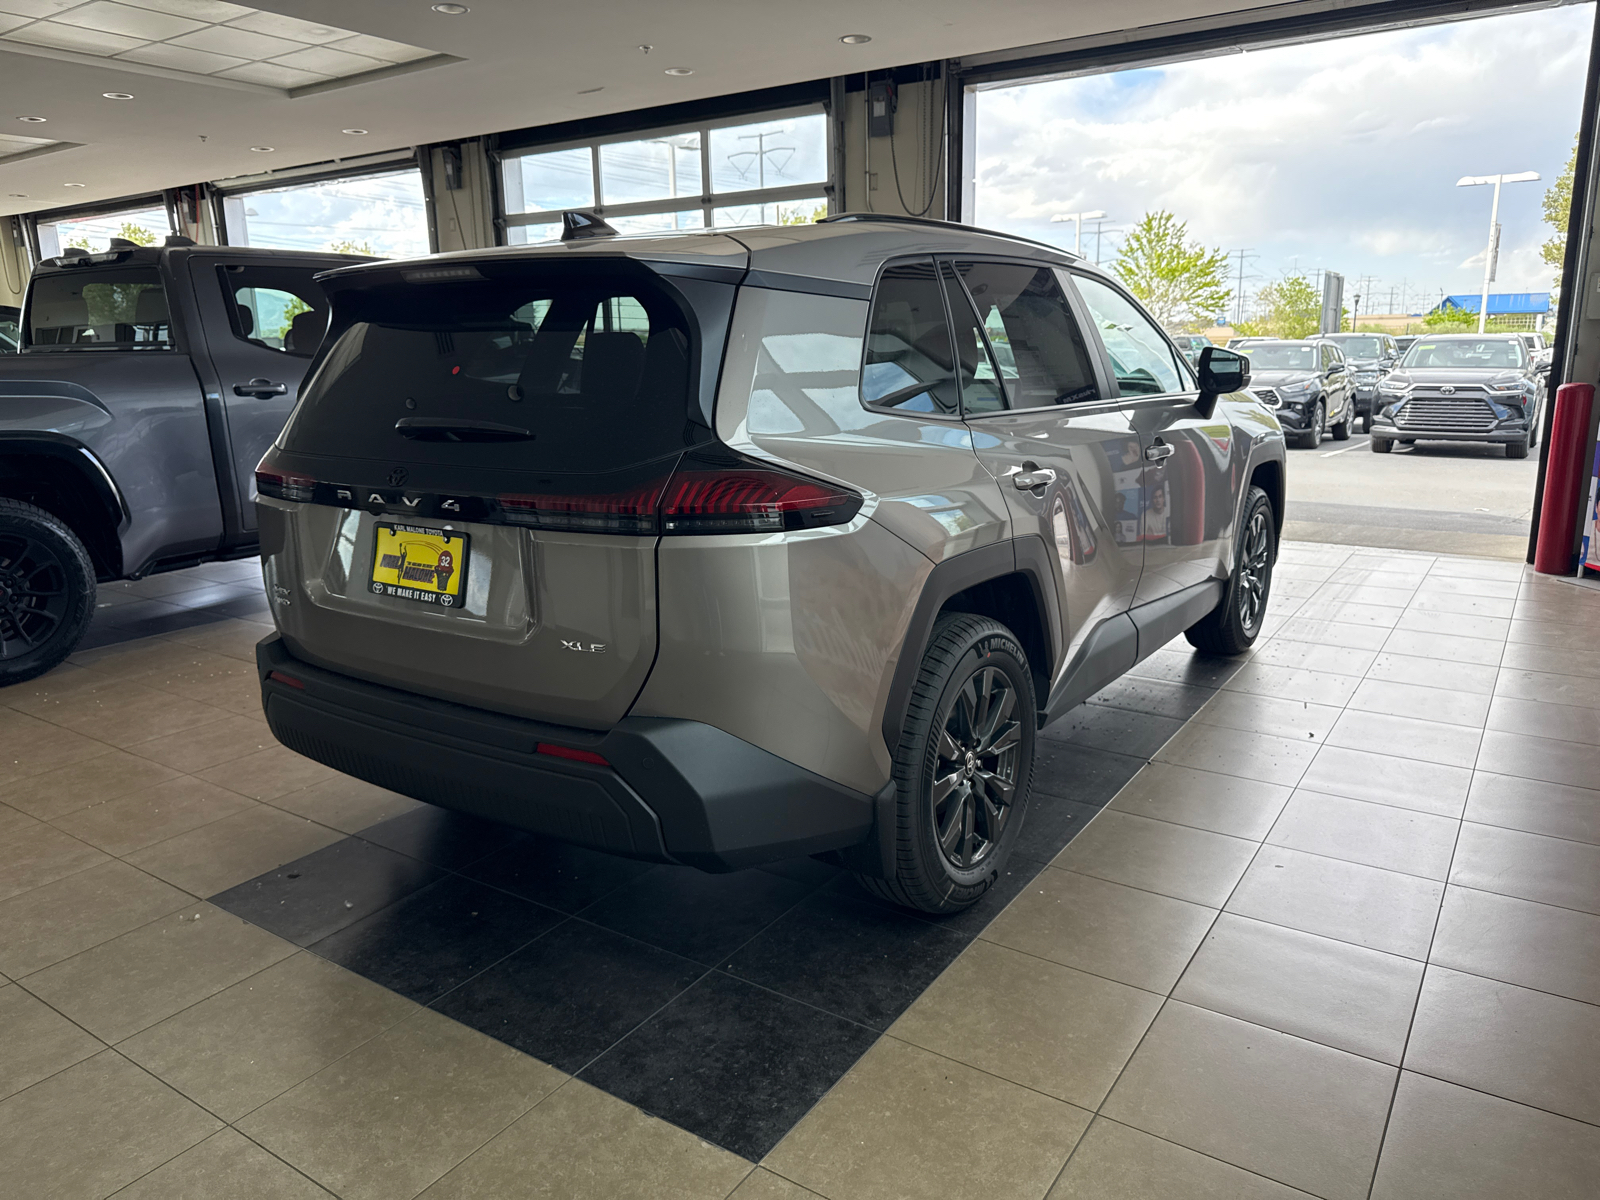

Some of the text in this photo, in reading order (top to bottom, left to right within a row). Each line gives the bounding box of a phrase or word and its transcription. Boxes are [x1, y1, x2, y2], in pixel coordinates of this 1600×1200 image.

[337, 489, 460, 512] RAV4
[394, 524, 444, 536] KARL MALONE TOYOTA
[440, 556, 451, 567] 32
[402, 566, 435, 583] MALONE
[387, 586, 436, 602] WE MAKE IT EASY
[560, 639, 607, 654] XLE
[990, 637, 1025, 666] MICHELIN
